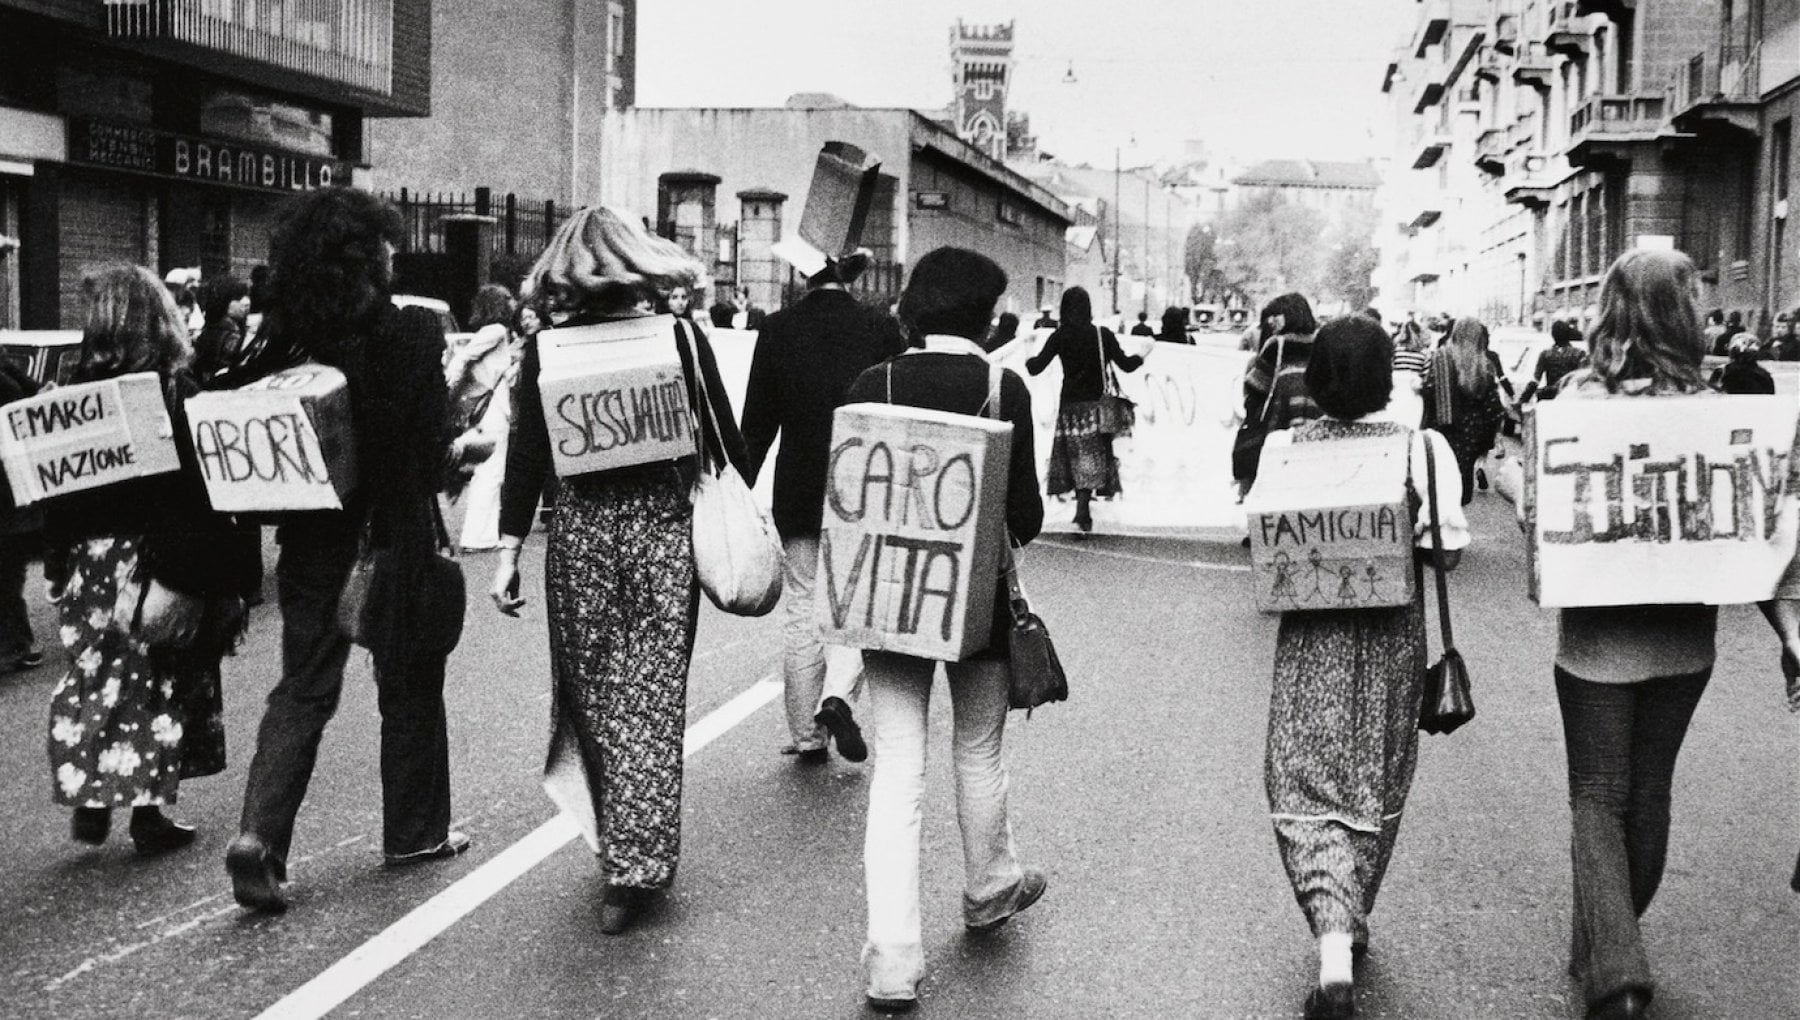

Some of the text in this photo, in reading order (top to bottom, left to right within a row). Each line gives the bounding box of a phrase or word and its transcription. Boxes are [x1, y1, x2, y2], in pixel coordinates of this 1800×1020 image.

[175, 140, 332, 190] BRAMBILLA
[36, 443, 137, 493] NAZIONE
[827, 436, 976, 531] CARO
[1259, 505, 1397, 547] FAMIGLIA
[819, 528, 964, 642] VITA
